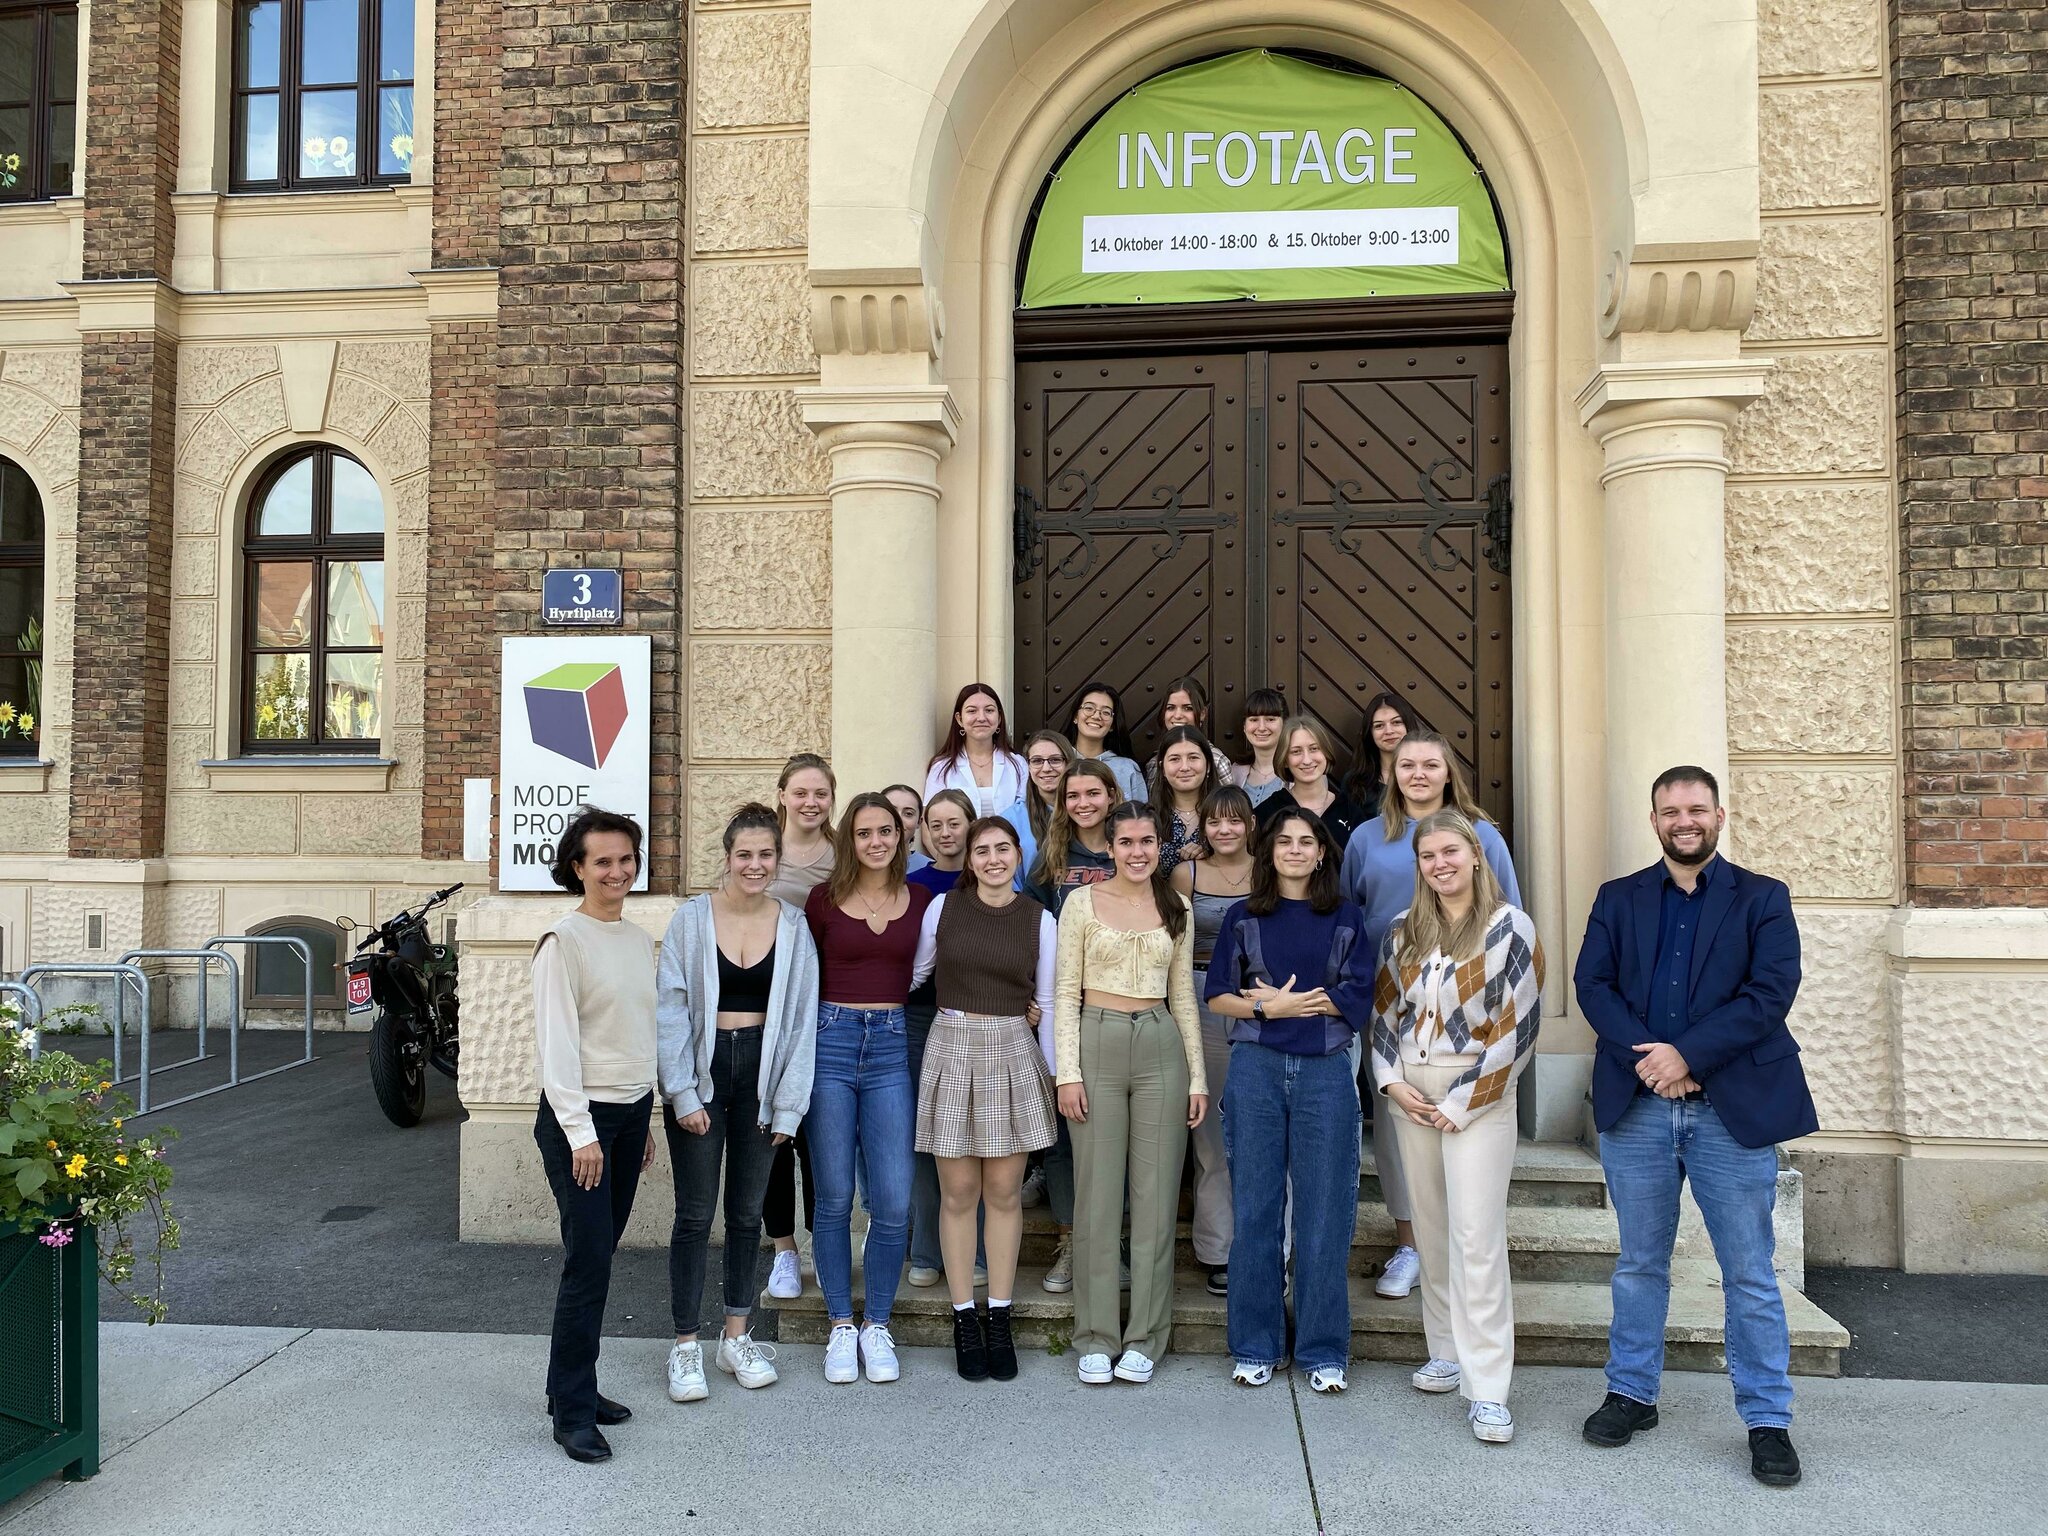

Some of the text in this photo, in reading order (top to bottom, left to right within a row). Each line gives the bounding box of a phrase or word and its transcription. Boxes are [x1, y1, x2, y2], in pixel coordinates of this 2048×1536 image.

[1117, 127, 1418, 189] INFOTAGE
[1090, 238, 1111, 252] 14.
[1114, 237, 1164, 252] Oktober
[1170, 235, 1208, 250] 14:00
[1219, 234, 1258, 249] 18:00
[1268, 233, 1279, 248] &
[1286, 233, 1307, 247] 15.
[1311, 232, 1362, 247] Oktober
[1368, 230, 1399, 245] 9:00
[1410, 229, 1450, 245] 13:00
[572, 573, 592, 605] 3
[549, 607, 615, 622] Hyrtlplatz
[514, 785, 590, 807] MODE
